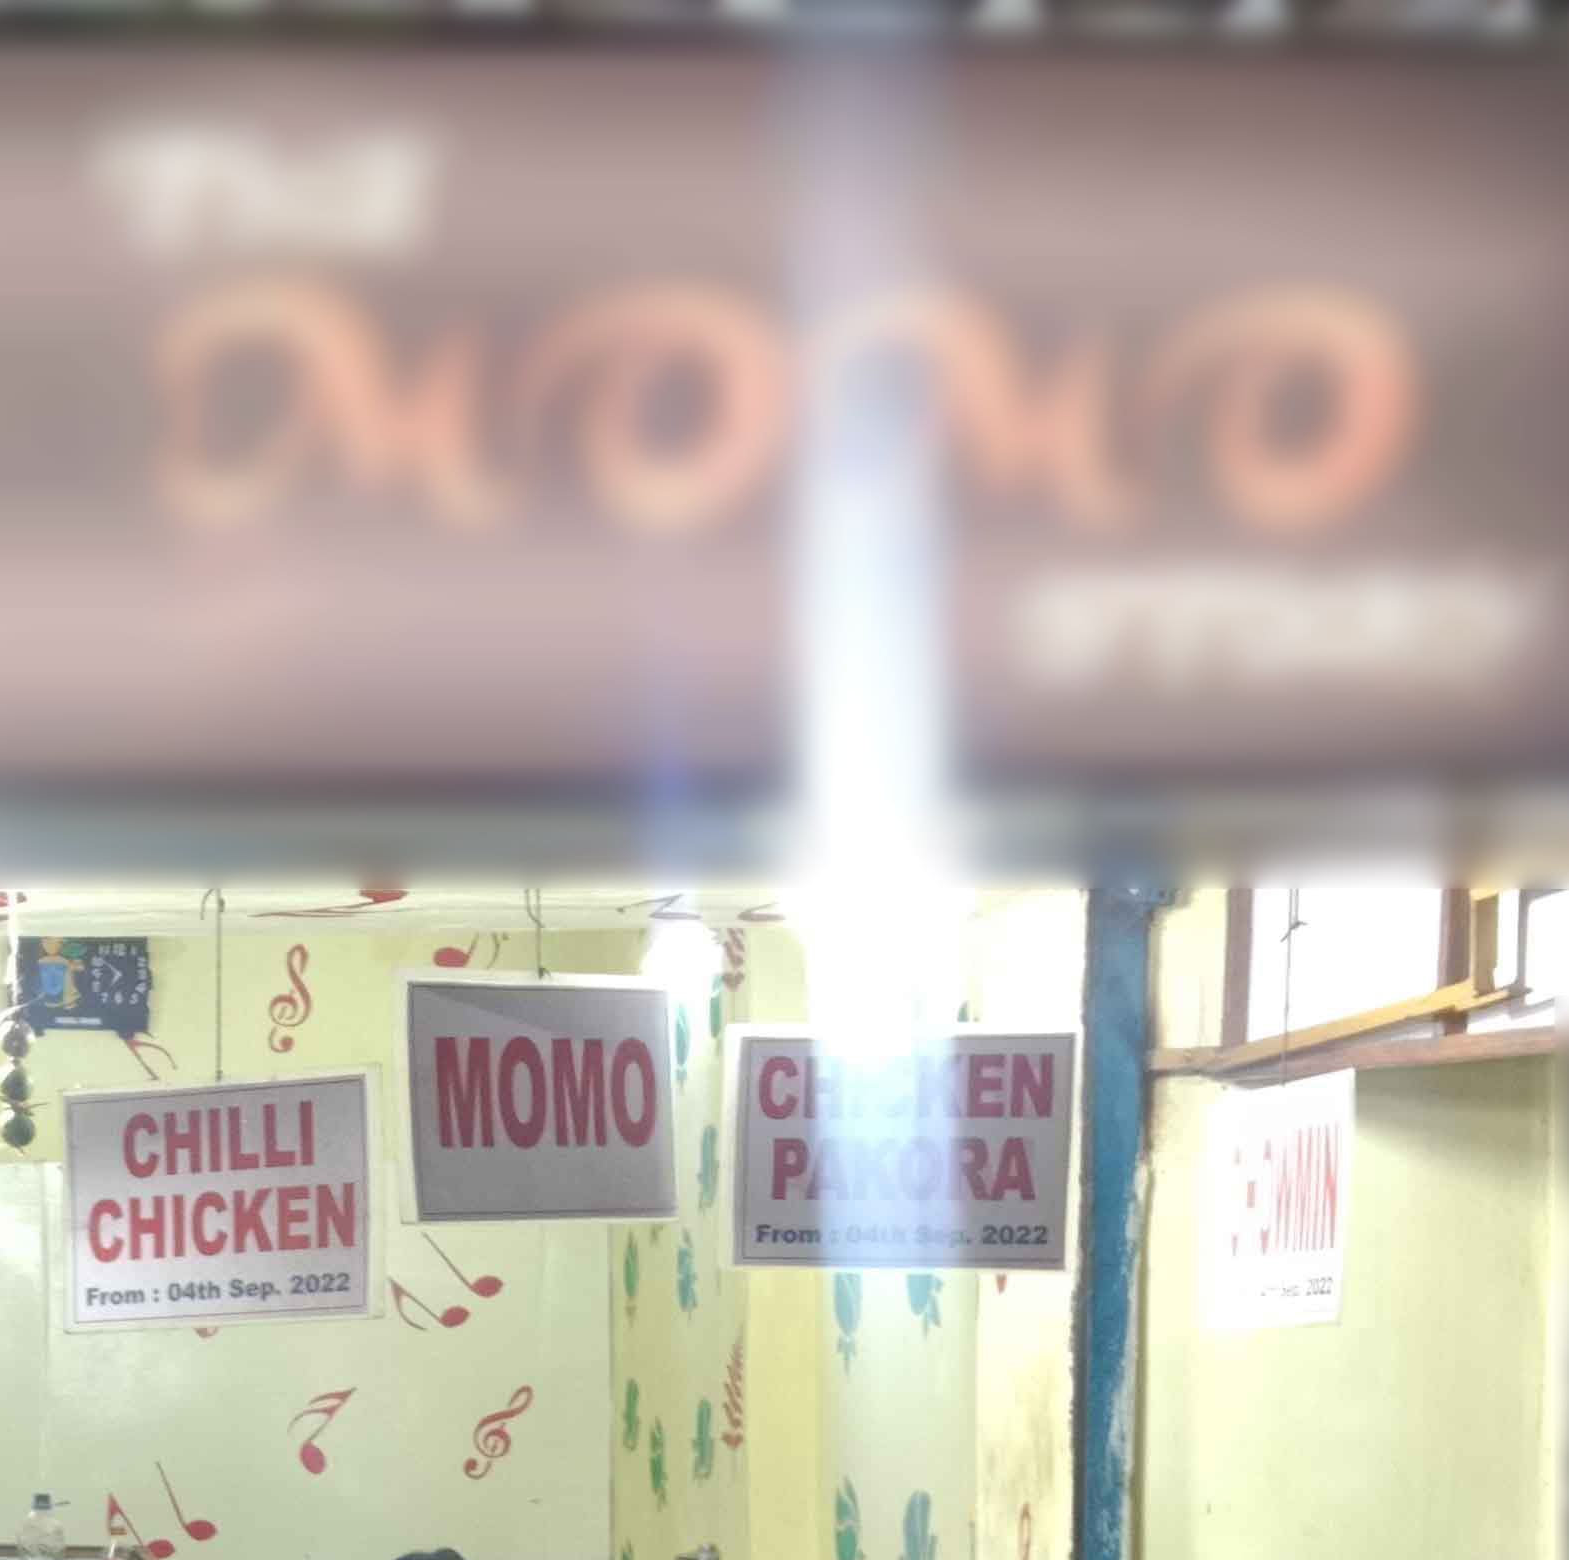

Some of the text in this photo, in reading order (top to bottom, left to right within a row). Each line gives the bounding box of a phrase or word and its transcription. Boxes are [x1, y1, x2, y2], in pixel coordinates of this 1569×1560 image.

[434, 1036, 657, 1149] MOMO
[123, 1101, 315, 1179] CHILLI
[87, 1182, 357, 1263] CHICKEN
[755, 1225, 821, 1244] From
[982, 1225, 1047, 1245] 2022
[86, 1287, 145, 1306] From
[168, 1281, 221, 1302] 04th
[228, 1278, 280, 1300] Sep.
[289, 1272, 351, 1295] 2022
